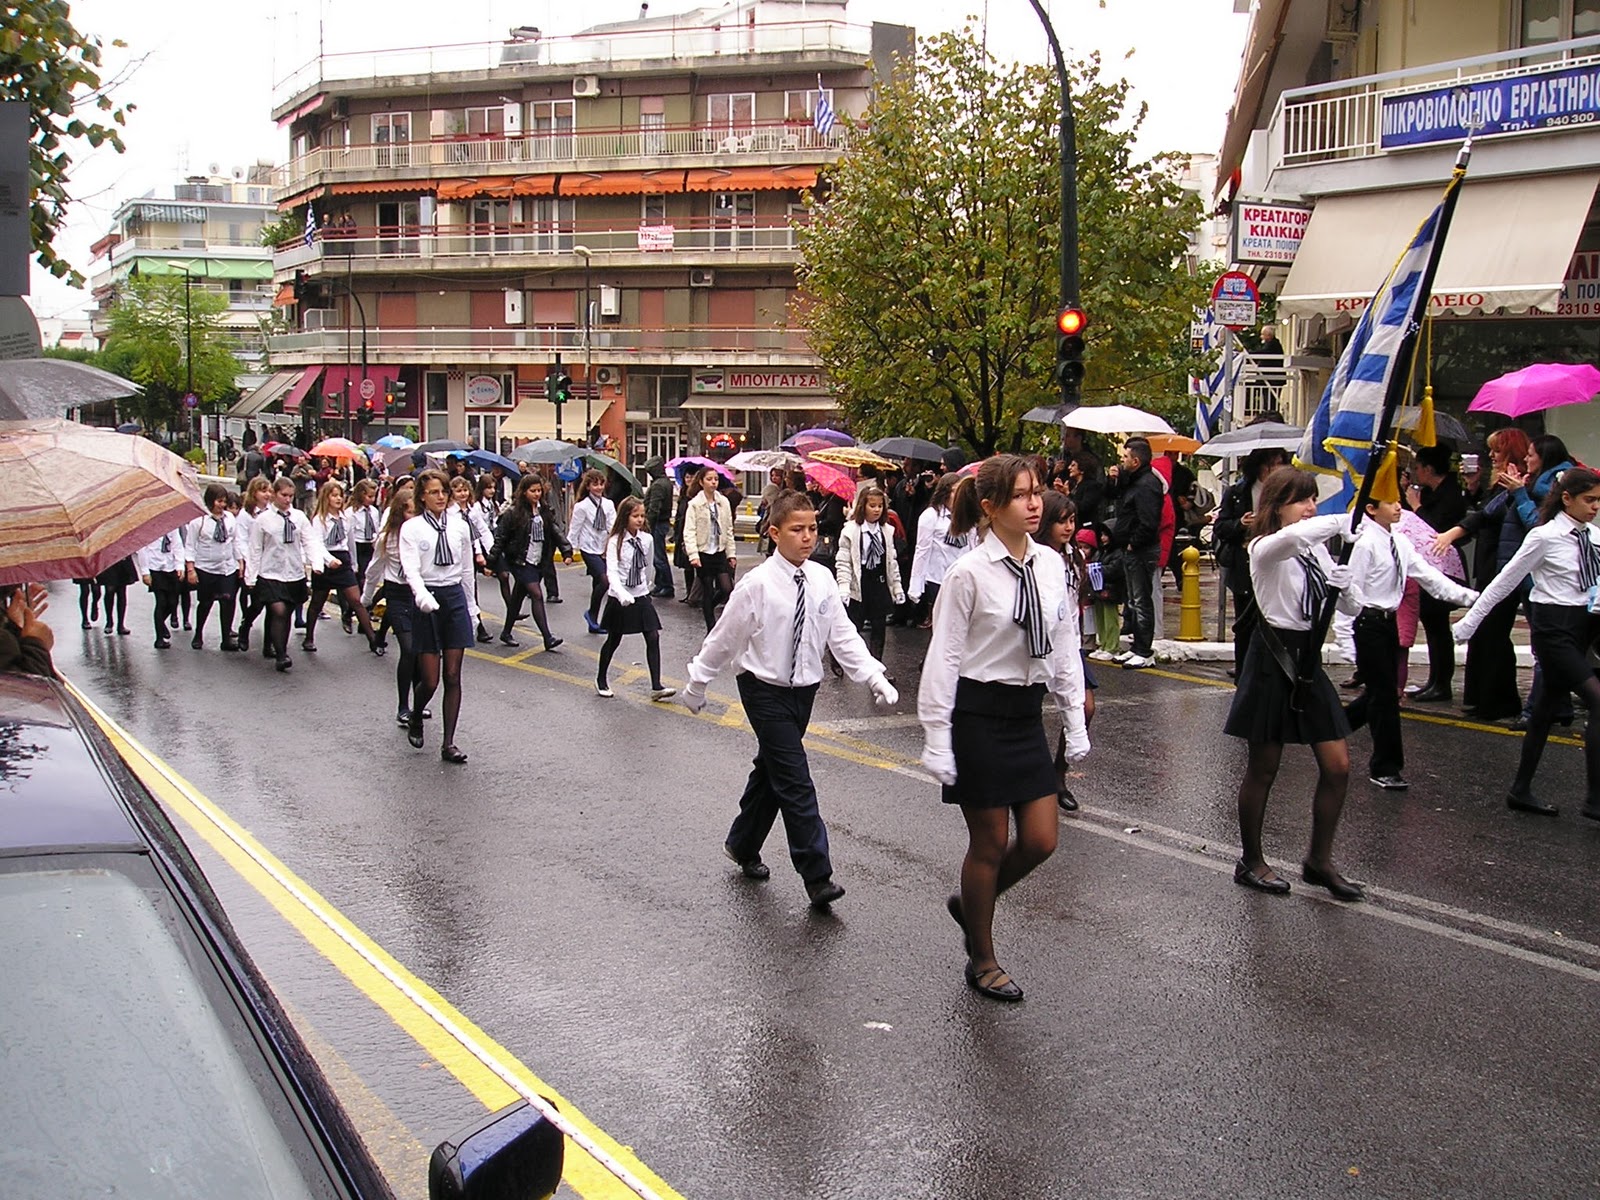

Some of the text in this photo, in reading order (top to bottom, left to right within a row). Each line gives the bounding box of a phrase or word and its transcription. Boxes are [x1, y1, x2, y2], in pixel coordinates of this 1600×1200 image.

[1546, 116, 1569, 127] 940
[1571, 112, 1595, 123] 300
[1242, 237, 1273, 249] ΚΡΕΑΤΑ
[1264, 250, 1283, 260] 2310
[1557, 303, 1590, 315] 2310
[730, 374, 819, 387] ΜΠΟΥΓΑΤΣΑ
